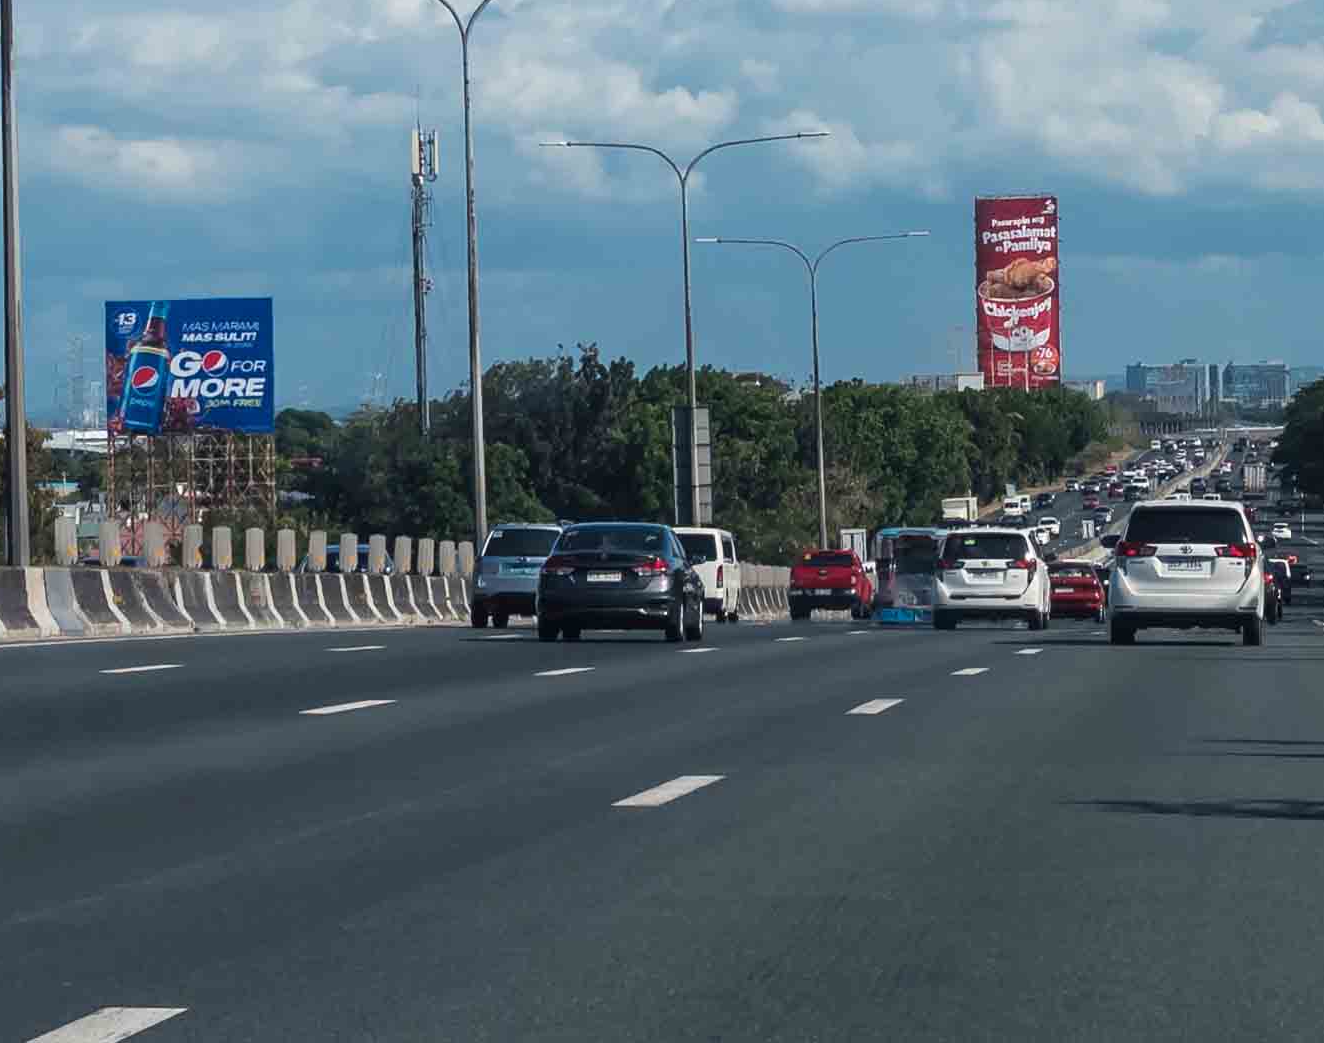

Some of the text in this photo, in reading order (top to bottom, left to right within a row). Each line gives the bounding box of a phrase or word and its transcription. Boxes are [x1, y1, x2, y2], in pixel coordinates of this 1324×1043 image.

[1003, 237, 1051, 253] Pamilya
[182, 322, 209, 332] MAS
[182, 333, 213, 342] MAS
[230, 359, 267, 373] FOR
[171, 377, 266, 398] MORE
[231, 398, 262, 407] FREE
